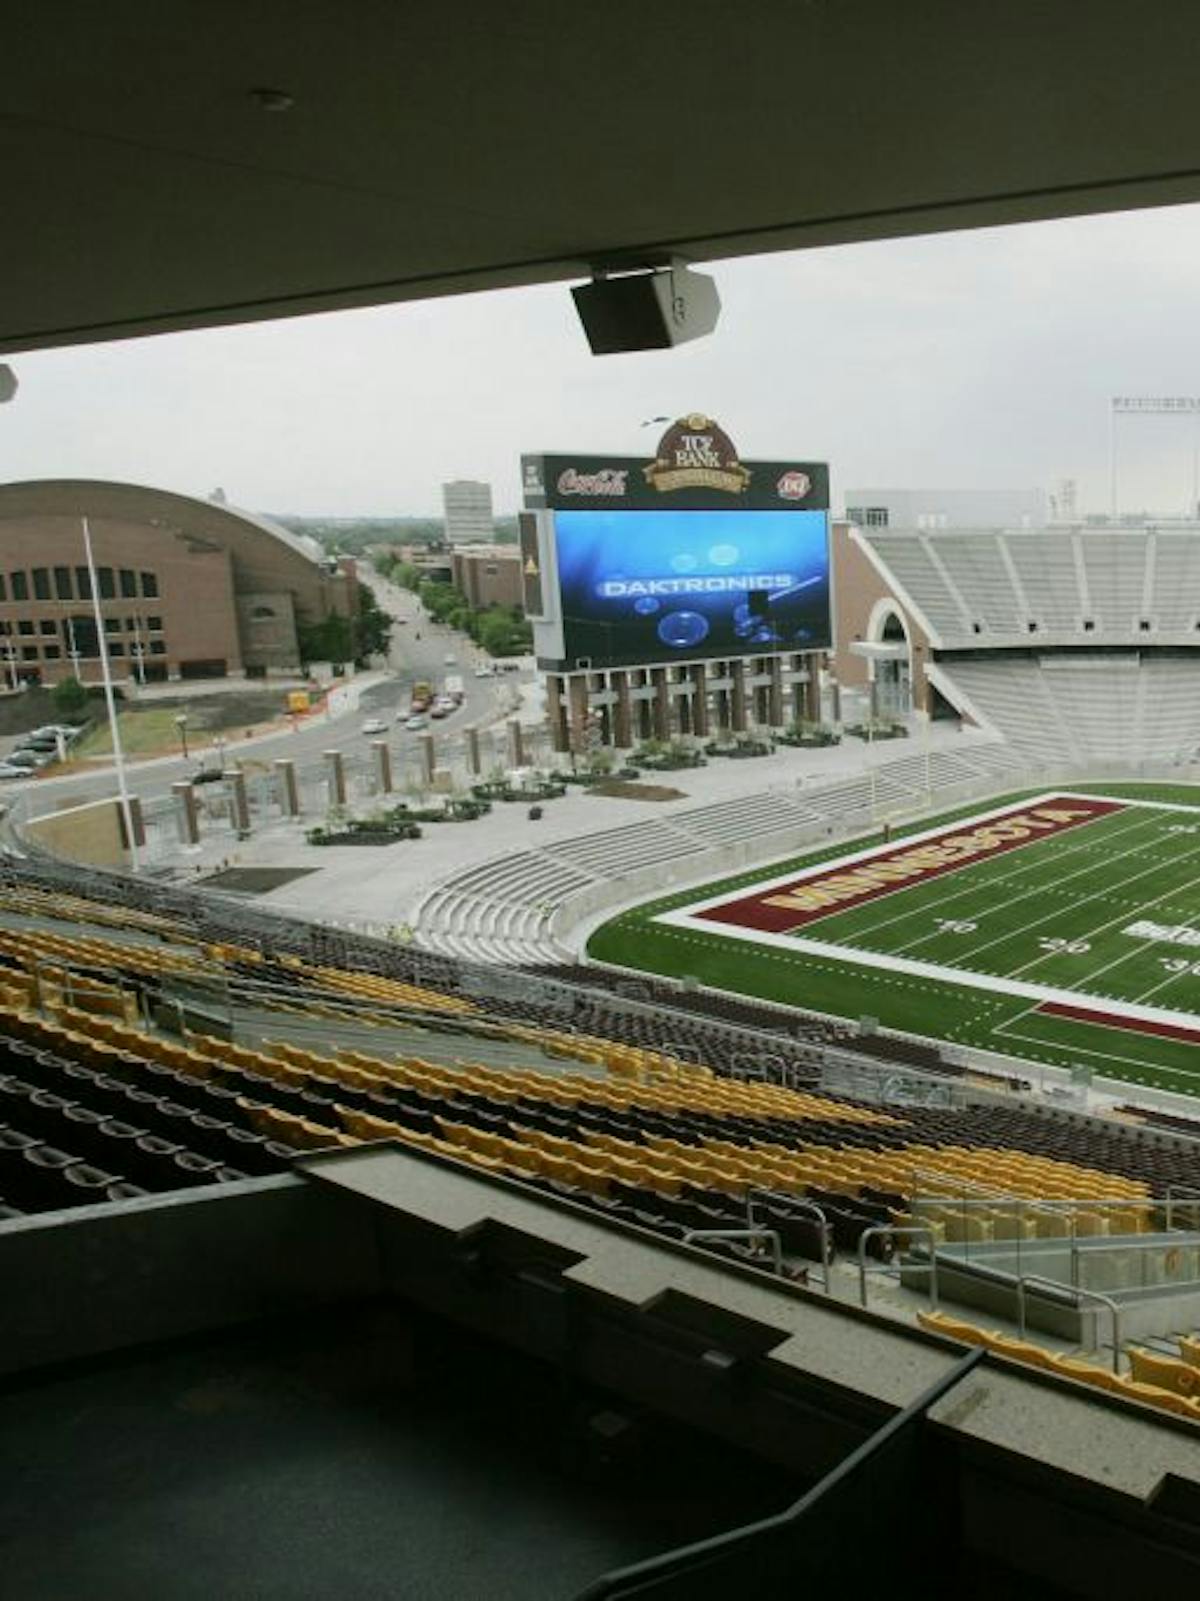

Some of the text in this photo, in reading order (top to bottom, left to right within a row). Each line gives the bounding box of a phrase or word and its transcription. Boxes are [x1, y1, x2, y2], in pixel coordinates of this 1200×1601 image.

[674, 450, 721, 468] BANK
[603, 574, 795, 596] DAKTRONICS
[760, 807, 1094, 912] MINNESOTA
